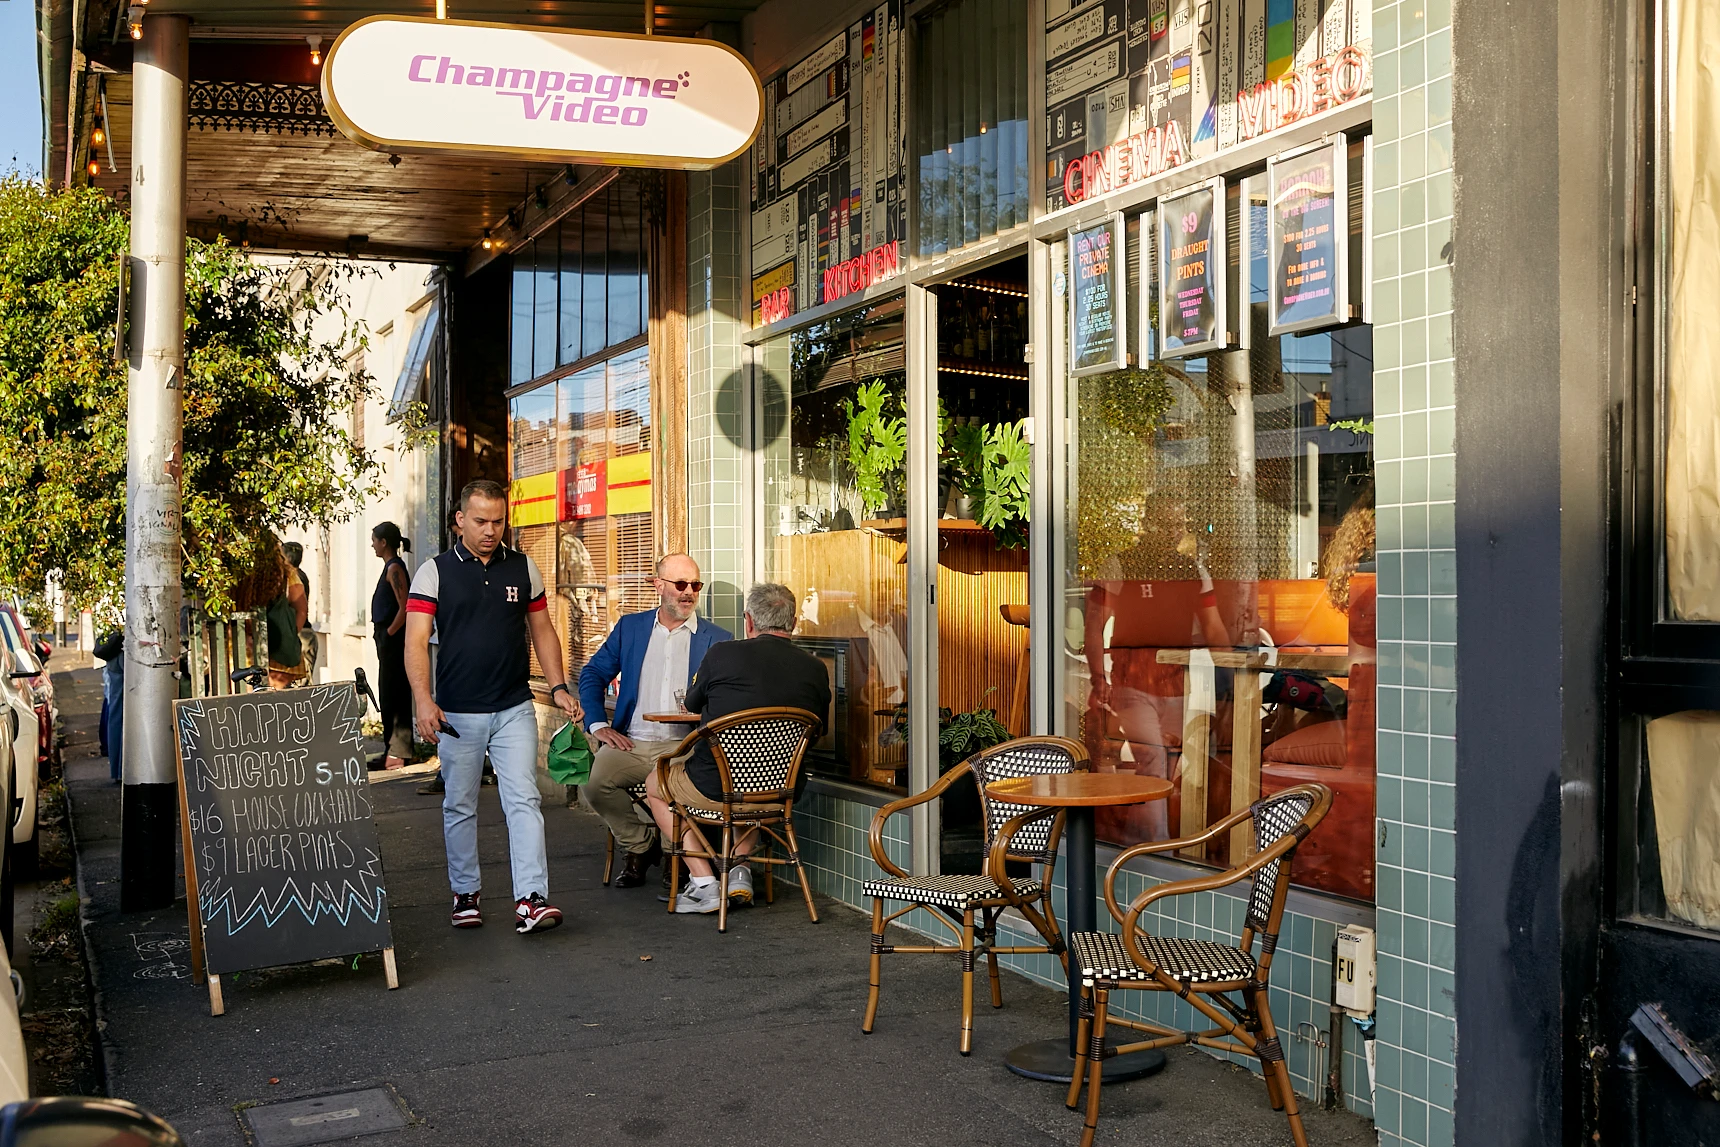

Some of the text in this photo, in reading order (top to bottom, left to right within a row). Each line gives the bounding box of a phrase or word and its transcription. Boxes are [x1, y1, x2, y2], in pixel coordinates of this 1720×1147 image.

[1174, 11, 1189, 28] VHS
[408, 54, 680, 103] Champagne
[1110, 94, 1125, 111] VHS
[1238, 46, 1367, 140] VIDEO
[496, 91, 648, 127] Video
[1064, 120, 1184, 205] CINEMA
[1182, 211, 1198, 236] $9
[1304, 227, 1315, 239] 2.25
[1077, 232, 1111, 254] RENT OUR
[1171, 239, 1209, 261] DRAUGHT
[1295, 244, 1302, 253] 30
[1079, 246, 1110, 267] PRIVATE
[824, 240, 898, 304] KITCHEN
[1081, 262, 1109, 279] CINEMA
[1176, 260, 1205, 280] PINTS
[1097, 283, 1106, 293] FOR
[1177, 286, 1205, 299] WEDNESDAY
[760, 286, 789, 326] BAR
[1179, 297, 1203, 309] THURSDAY
[1182, 308, 1199, 318] FRIDAY
[505, 586, 519, 602] H
[208, 699, 316, 750] HAPPY
[196, 748, 361, 792] NIGHT 5-10
[189, 788, 374, 835] $16 HOUSE COCKTAILS
[202, 830, 356, 876] $9 LAGER PINTS
